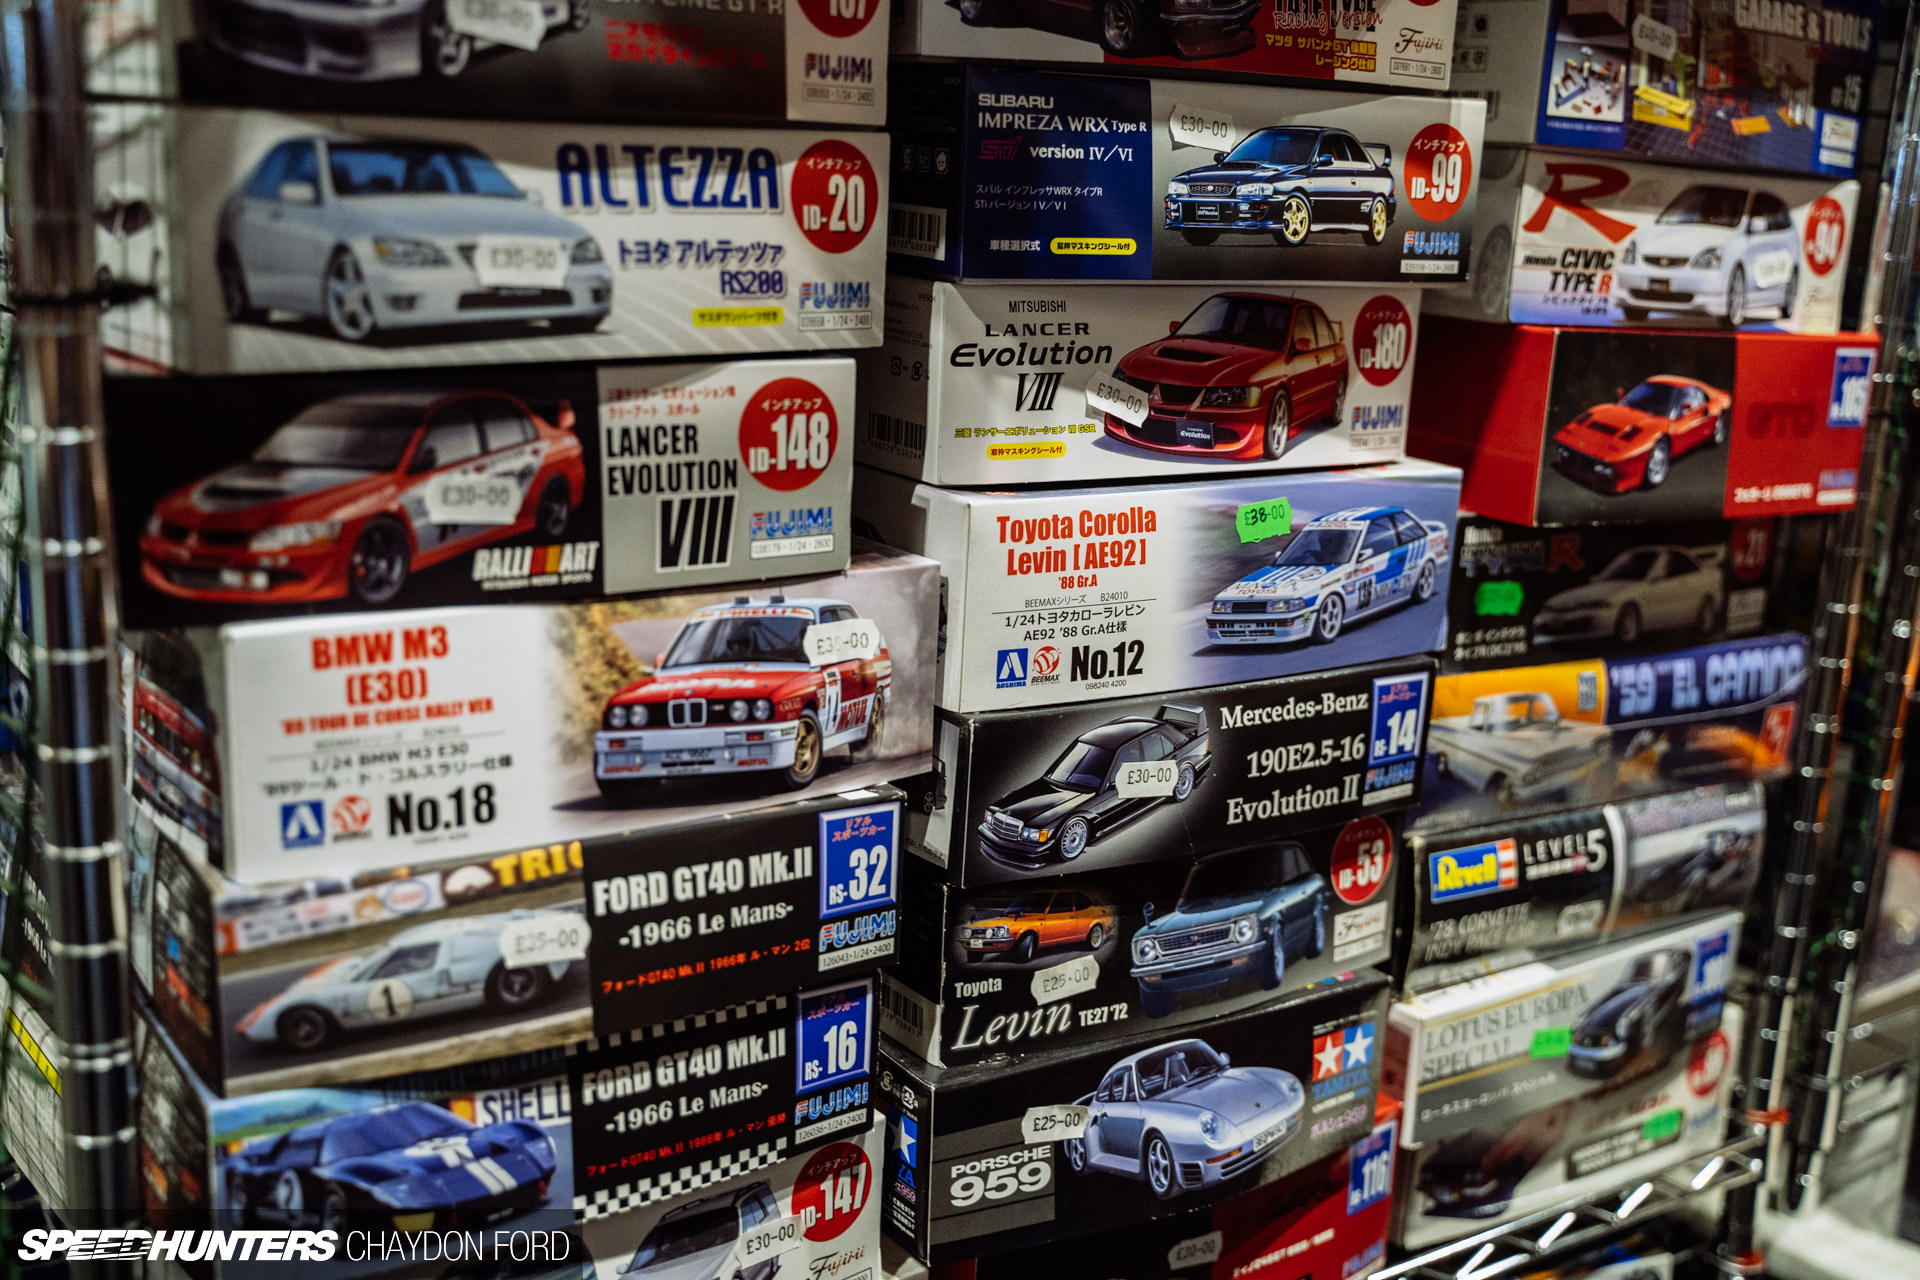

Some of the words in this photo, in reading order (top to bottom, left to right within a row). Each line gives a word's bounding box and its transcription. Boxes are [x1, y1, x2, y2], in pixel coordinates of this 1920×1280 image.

[1272, 11, 1328, 36] Racing
[1331, 11, 1384, 29] Version
[1265, 34, 1293, 47] マツダ
[1394, 28, 1444, 54] Fujimi
[806, 52, 873, 84] FUJIMI
[978, 94, 1054, 109] SUBARU
[978, 112, 1063, 131] IMPREZA
[1067, 115, 1109, 133] WRX
[1111, 119, 1137, 133] Type
[1140, 121, 1147, 132] R
[1180, 115, 1228, 138] £30-00
[1029, 144, 1084, 159] version
[1415, 138, 1465, 152] インチアップ
[556, 143, 781, 211] ALTEZZA
[806, 158, 862, 171] インチアップ
[1411, 152, 1462, 203] ID-99
[802, 174, 866, 232] ID-20
[990, 240, 1041, 252] 車種選択式
[1403, 231, 1460, 255] FUJIMI
[1561, 248, 1615, 271] CIVIC
[720, 270, 784, 296] RS200
[800, 282, 870, 309] FUJIMI
[1549, 272, 1597, 293] TYPE
[1598, 274, 1613, 295] R
[1009, 300, 1067, 313] MITSUBISHI
[985, 322, 1090, 337] LANCER
[950, 340, 1113, 367] Evolution
[1360, 323, 1406, 370] ID-180
[762, 398, 822, 411] インチアップ
[1015, 372, 1065, 412] VIII
[1096, 382, 1142, 414] £30-00
[1078, 424, 1096, 434] GSR
[1351, 405, 1403, 431] FUJIMI
[606, 424, 698, 458] LANCER
[749, 412, 830, 474] ID-148
[1180, 429, 1211, 440] Evolution
[608, 460, 738, 496] EVOLUTION
[750, 506, 832, 540] FUJIMI
[997, 514, 1073, 545] Toyota
[1079, 507, 1157, 538] Corolla
[1244, 504, 1285, 527] £38-00
[659, 496, 735, 568] VIII
[1007, 546, 1067, 576] Levin
[1058, 576, 1075, 590] '88
[1077, 574, 1098, 588] Gr.A
[719, 608, 786, 618] PIRELLI
[1025, 595, 1087, 609] BEEMAXシリーズ
[1100, 591, 1129, 602] B24010
[1005, 605, 1146, 628] 1/24トヨタカローラレビン
[312, 631, 393, 671] BMW
[402, 626, 450, 659] M3
[1023, 628, 1056, 642] AE92
[1059, 625, 1078, 638] '88
[1070, 640, 1145, 682] No.12
[996, 681, 1027, 690] AOSHIMA
[1031, 674, 1060, 684] BEEMAX
[1085, 681, 1110, 691] 098240
[1111, 679, 1127, 688] 4200
[310, 713, 347, 733] TOUR
[1220, 692, 1369, 730] Mercedes-Benz
[359, 751, 399, 766] BMW
[1247, 733, 1366, 779] 190E2.5-16
[1127, 767, 1172, 785] £30-00
[1364, 760, 1416, 791] FUJIMI
[388, 783, 496, 837] No.18
[1226, 783, 1339, 825] Evolution
[1341, 774, 1361, 803] II
[832, 825, 886, 842] スポーツカー
[1339, 839, 1385, 890] ID-53
[1524, 833, 1587, 864] LEVEL
[1586, 828, 1608, 873] 5
[592, 871, 669, 916] FORD
[672, 857, 745, 902] GT40
[748, 845, 813, 888] Mk.II
[829, 845, 888, 906] RS-32
[1437, 852, 1498, 892] Revell
[619, 916, 693, 948] -1966
[698, 912, 725, 936] Le
[730, 901, 794, 928] Mans-
[819, 910, 896, 952] FUJIMI
[380, 984, 396, 1017] 1
[955, 977, 1002, 998] Toyota
[951, 1002, 1071, 1050] Levin
[1079, 1007, 1107, 1027] TE27
[1425, 1005, 1503, 1052] LOTUS
[1505, 982, 1589, 1028] EUROPA
[804, 1020, 858, 1081] RS-16
[582, 1061, 652, 1105] FORD
[656, 1045, 722, 1087] GT40
[727, 1028, 786, 1070] Mk.II
[1312, 1067, 1370, 1100] TAMIYA
[482, 1080, 571, 1125] SHELL
[605, 1101, 673, 1133] -1966
[679, 1096, 704, 1118] Le
[709, 1082, 768, 1108] Mans-
[795, 1083, 868, 1124] FUJIMI
[1032, 1112, 1080, 1132] £25-00
[951, 1145, 1051, 1178] PORSCHE
[950, 1160, 1051, 1207] 959
[746, 1223, 795, 1255] £30-00
